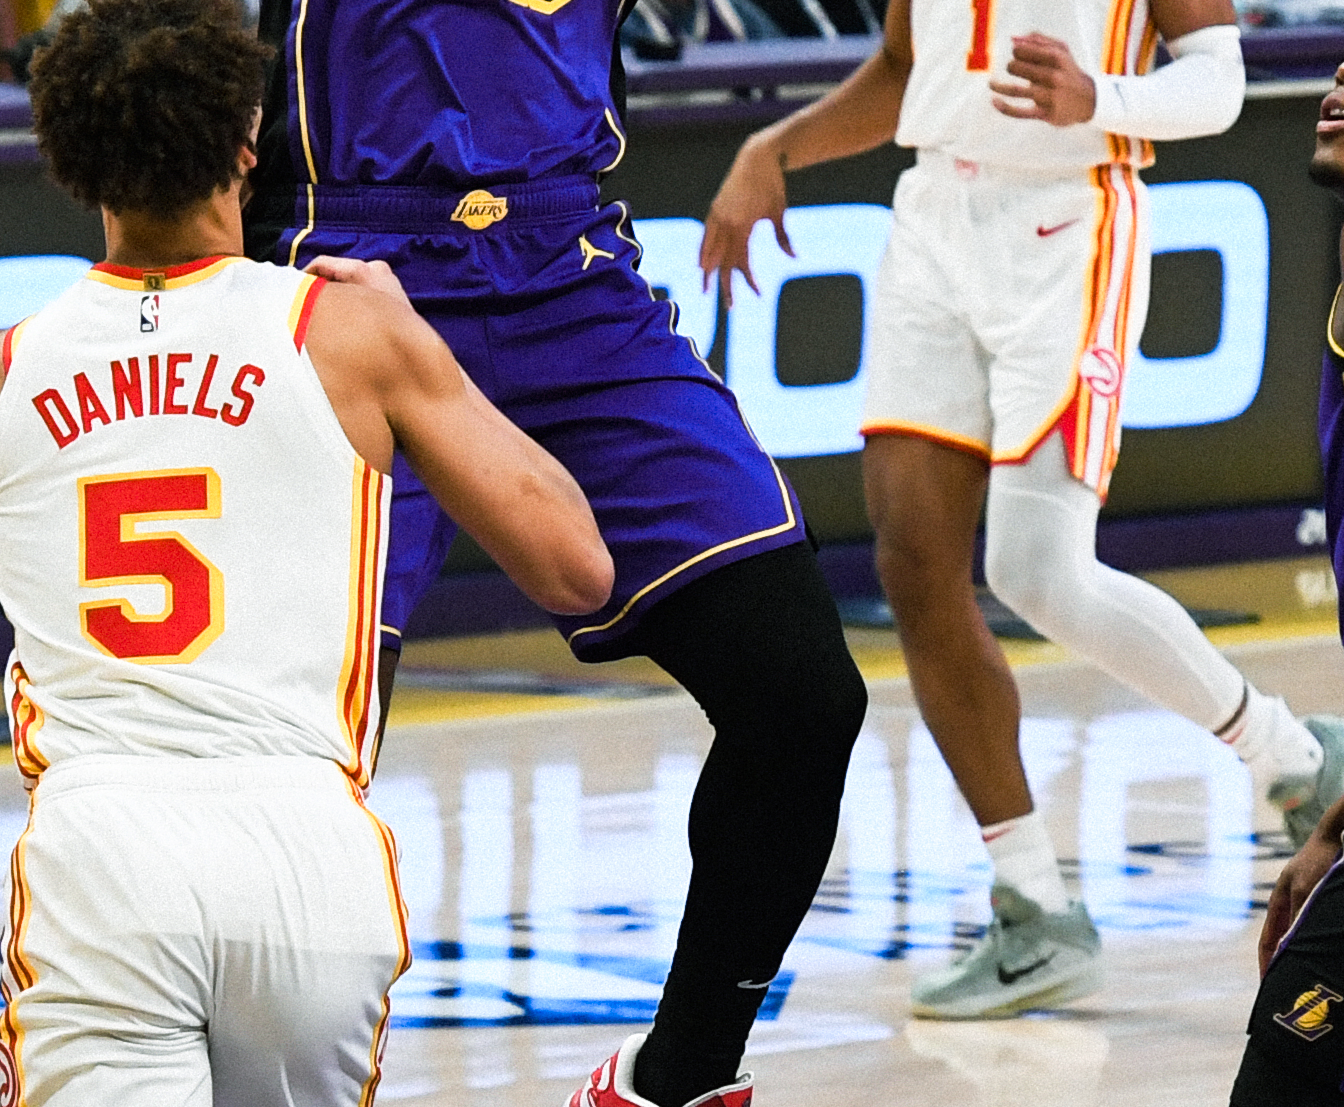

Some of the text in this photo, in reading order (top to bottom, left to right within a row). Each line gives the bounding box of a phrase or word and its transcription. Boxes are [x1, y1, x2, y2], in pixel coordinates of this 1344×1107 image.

[455, 201, 504, 221] LAKERS
[31, 352, 266, 450] DANIELS
[76, 466, 226, 666] 5
